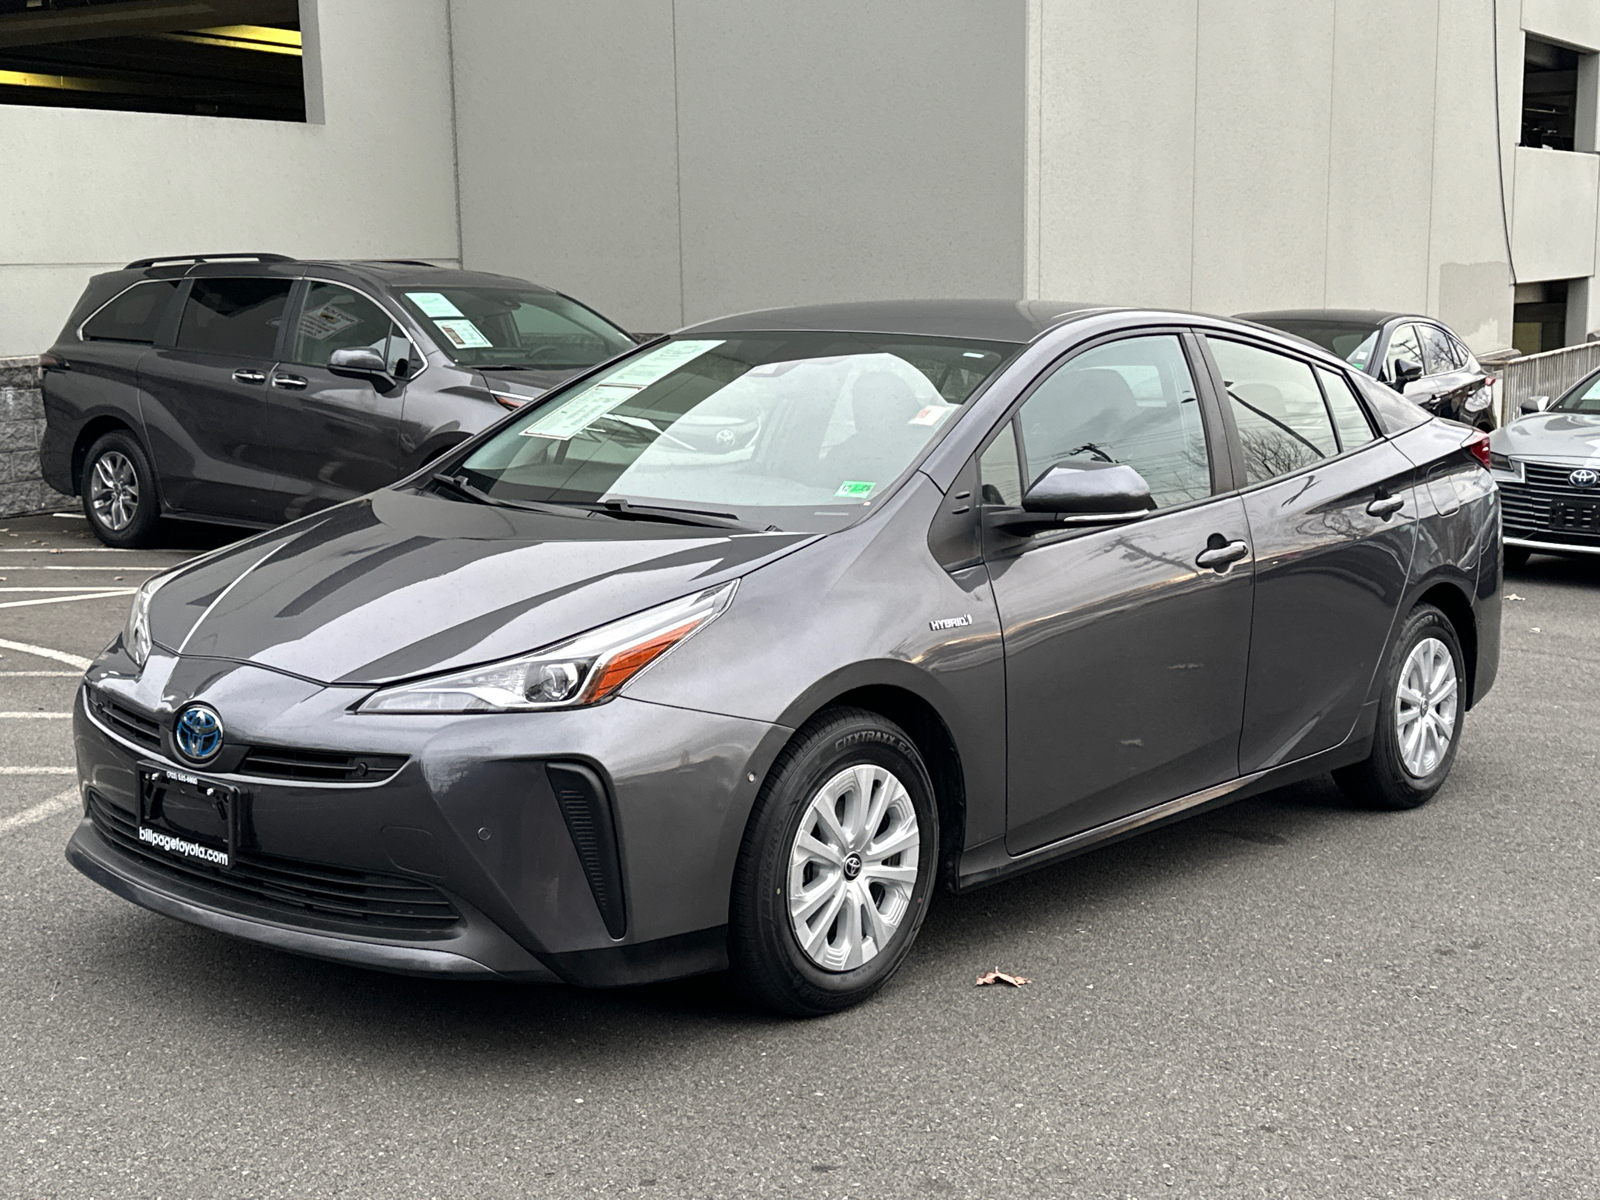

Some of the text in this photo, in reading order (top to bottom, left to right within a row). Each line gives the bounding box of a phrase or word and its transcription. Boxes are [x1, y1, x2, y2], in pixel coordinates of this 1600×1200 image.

[929, 616, 967, 631] HYBRID
[835, 730, 896, 752] CITYTRAXX
[138, 826, 229, 866] billpagetoyota.com
